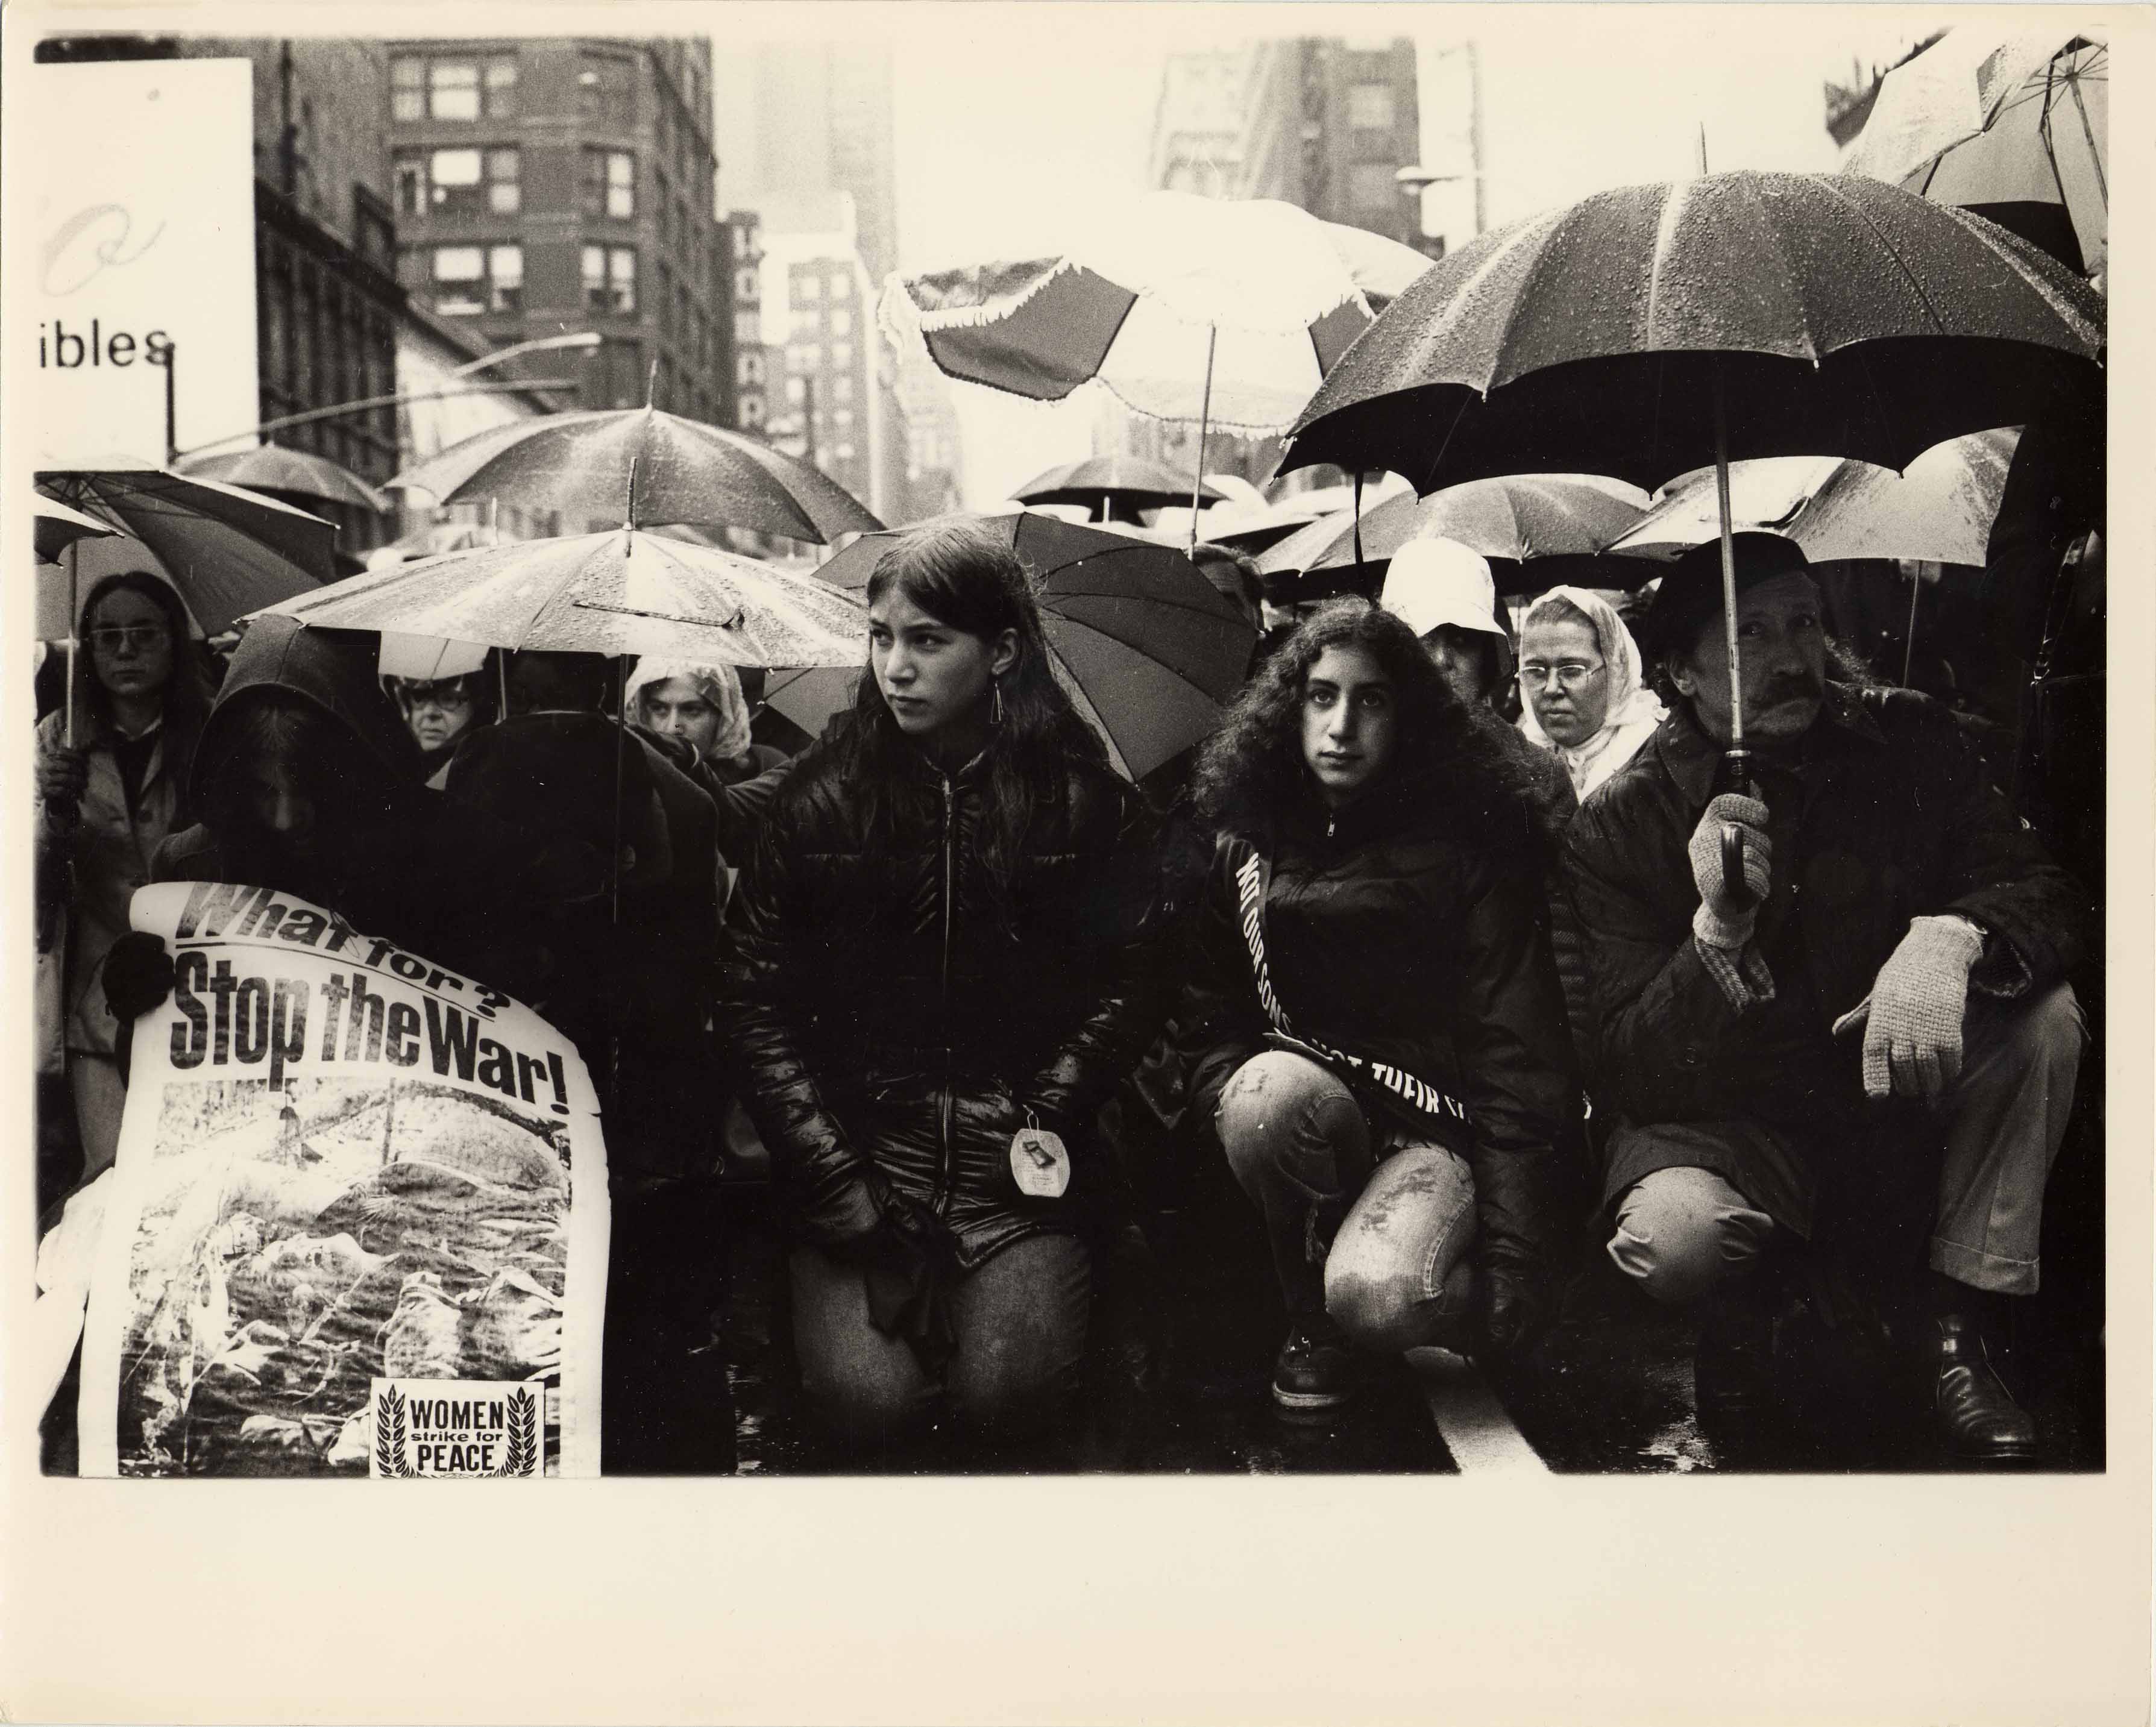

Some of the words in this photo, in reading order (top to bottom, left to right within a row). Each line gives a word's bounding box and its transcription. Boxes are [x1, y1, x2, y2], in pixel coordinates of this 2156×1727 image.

[39, 318, 173, 368] ibles
[1236, 853, 1260, 914] NOT
[175, 882, 359, 952] What
[365, 939, 464, 990] for
[1243, 907, 1264, 974] OUR
[170, 951, 309, 1091] Stop
[321, 973, 421, 1067] the
[423, 995, 570, 1115] War!
[410, 1400, 503, 1429] WOMEN
[410, 1431, 468, 1441] strike
[477, 1431, 503, 1441] for
[418, 1444, 494, 1472] PEACE
